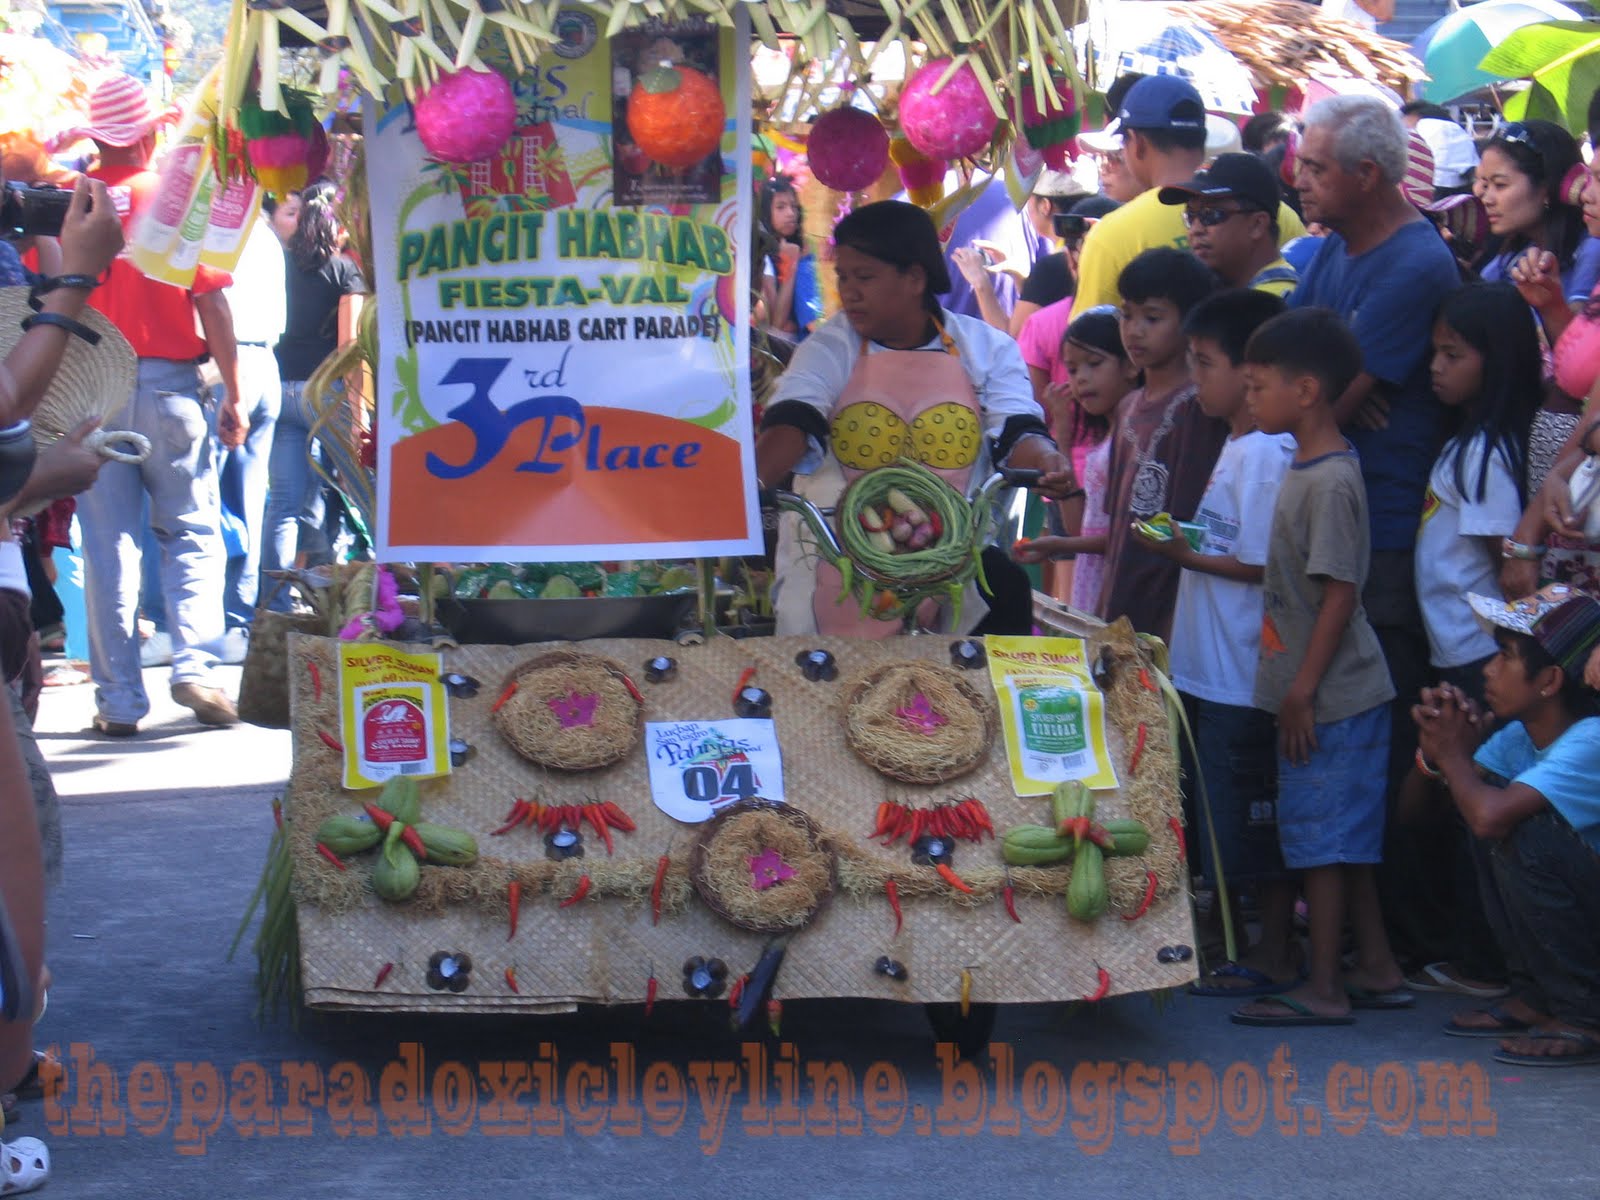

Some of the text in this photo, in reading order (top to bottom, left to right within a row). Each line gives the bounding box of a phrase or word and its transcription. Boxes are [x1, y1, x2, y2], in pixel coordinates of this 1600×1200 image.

[399, 212, 734, 280] PANCIT HABHAB
[438, 273, 692, 310] FIESTA-VAL
[405, 315, 722, 348] (PANCIT HABHAB CART PARADE)
[502, 396, 701, 474] Place
[346, 654, 393, 668] SILVER
[682, 763, 759, 802] 04
